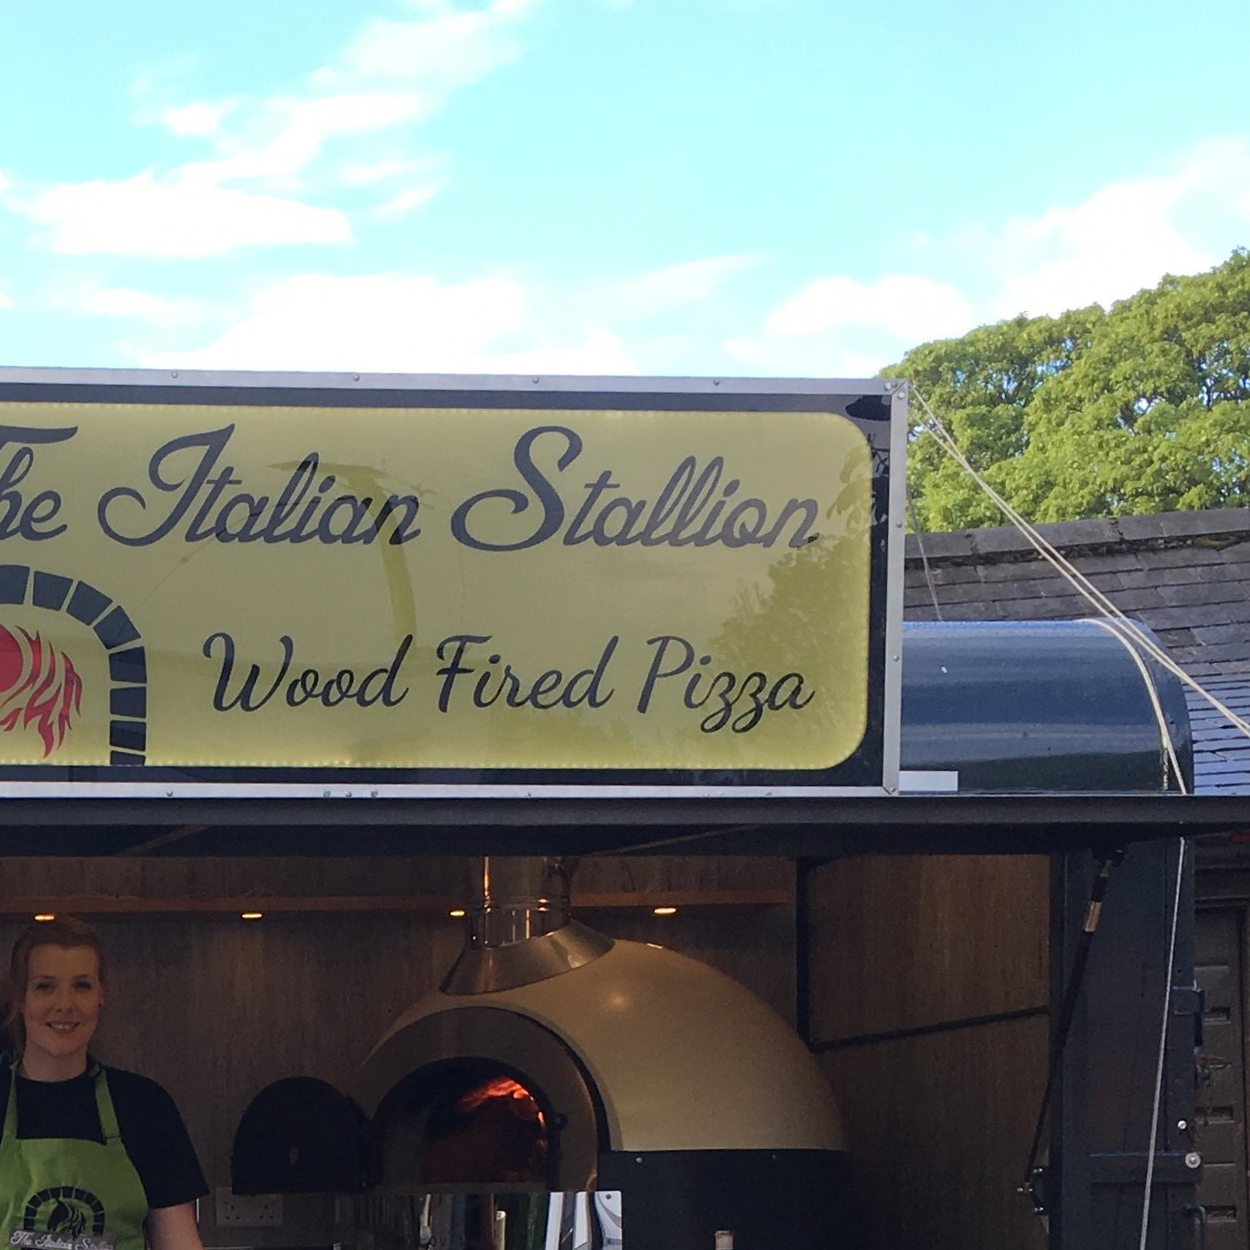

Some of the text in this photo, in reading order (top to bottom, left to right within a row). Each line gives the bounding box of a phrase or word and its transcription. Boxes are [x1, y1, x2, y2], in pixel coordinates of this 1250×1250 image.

[97, 422, 421, 549] Italian
[450, 424, 820, 552] Stallion
[200, 630, 815, 735] Wood Fired Pizza
